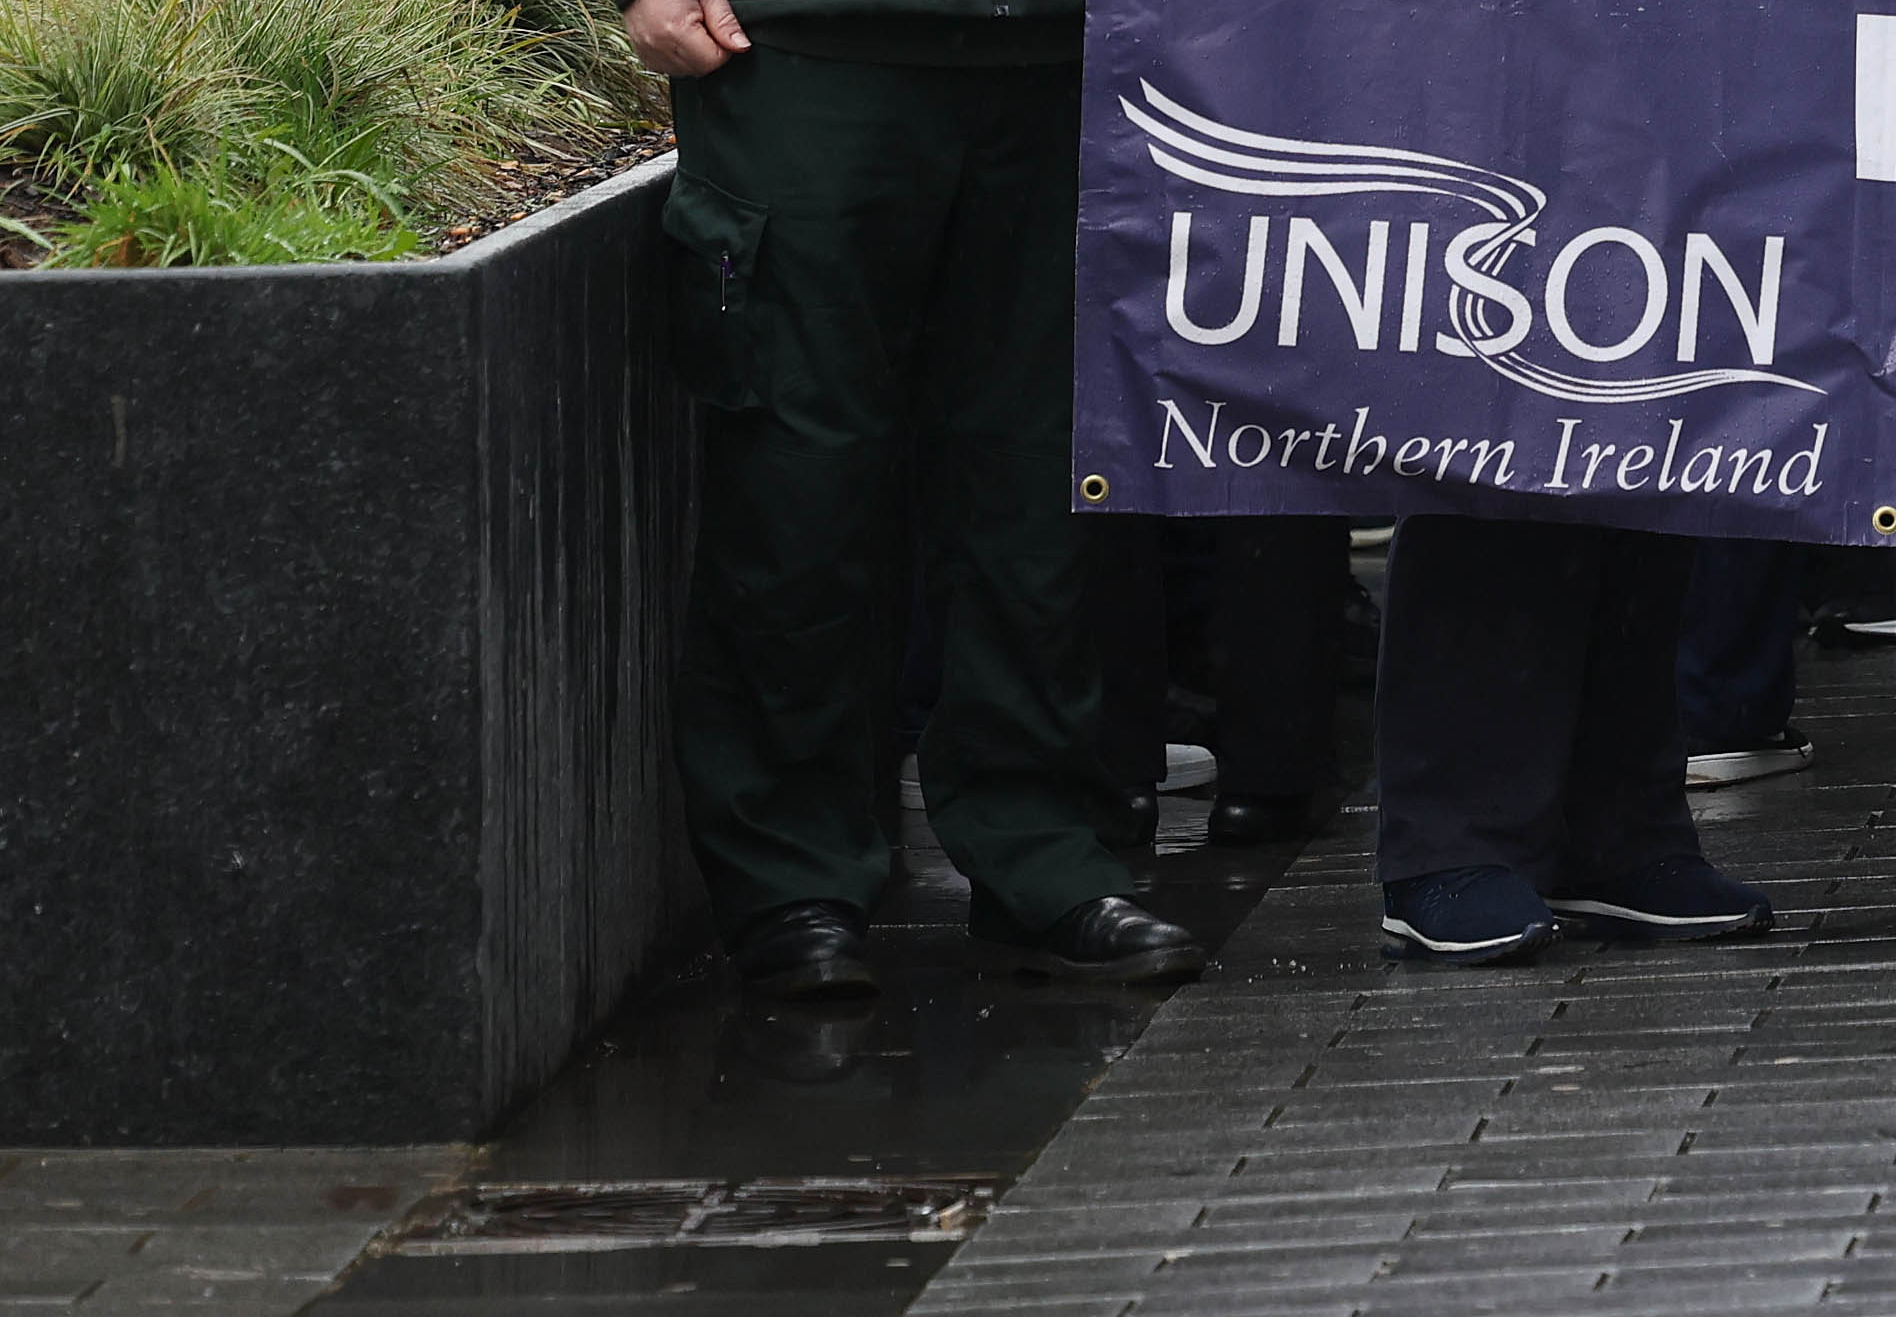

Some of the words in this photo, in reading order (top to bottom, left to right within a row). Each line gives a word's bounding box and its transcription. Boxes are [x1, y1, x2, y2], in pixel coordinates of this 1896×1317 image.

[1164, 210, 1785, 367] UNISON
[1154, 398, 1517, 488] Northern
[1544, 418, 1828, 499] Ireland
